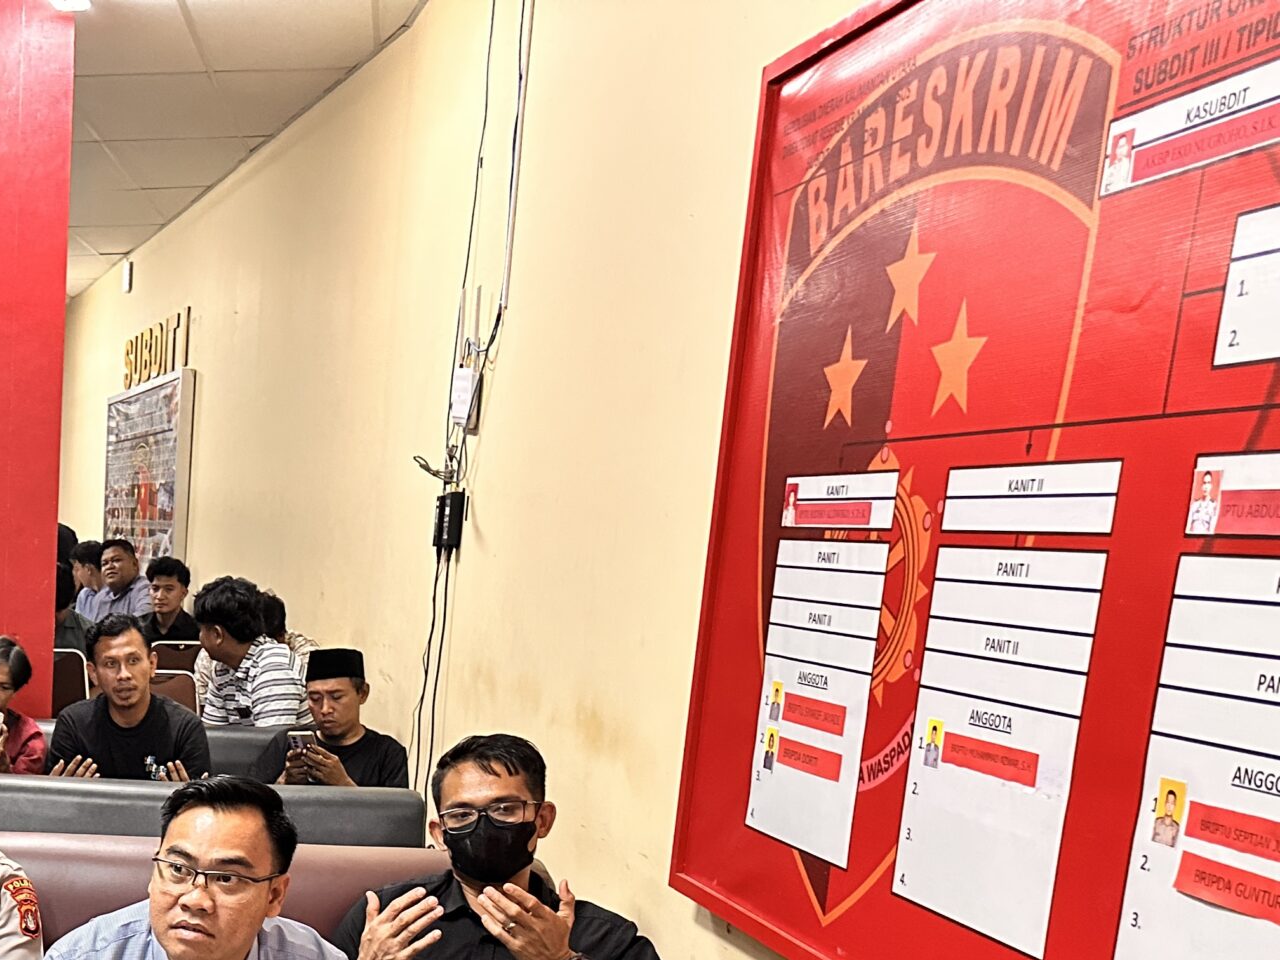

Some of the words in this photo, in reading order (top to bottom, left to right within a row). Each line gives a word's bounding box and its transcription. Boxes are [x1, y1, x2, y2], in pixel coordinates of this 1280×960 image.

[1126, 0, 1221, 60] STRUKTUR
[1133, 45, 1200, 95] SUBDIT
[1202, 36, 1221, 68] III
[1184, 87, 1250, 125] KASUBDIT
[807, 45, 1094, 258] BARESKRIM
[1237, 279, 1248, 297] 1.
[1228, 329, 1240, 347] 2.
[124, 312, 181, 390] SUBDIT
[826, 485, 845, 496] KANIT
[1007, 478, 1036, 492] KANIT
[1036, 478, 1045, 491] II
[817, 551, 837, 564] PANIT
[996, 561, 1025, 577] PANIT
[808, 612, 828, 625] PANIT
[984, 637, 1012, 653] PANIT
[1012, 640, 1020, 656] II
[797, 671, 829, 688] ANGGOTA
[969, 708, 1013, 732] ANGGOTA
[918, 736, 926, 750] 1.
[911, 781, 920, 796] 2.
[905, 827, 913, 842] 3.
[1140, 855, 1151, 872] 2.
[899, 873, 908, 887] 4.
[1193, 869, 1232, 894] BRIPDA
[1234, 882, 1280, 909] GUNTUR
[1130, 912, 1141, 929] 3.
